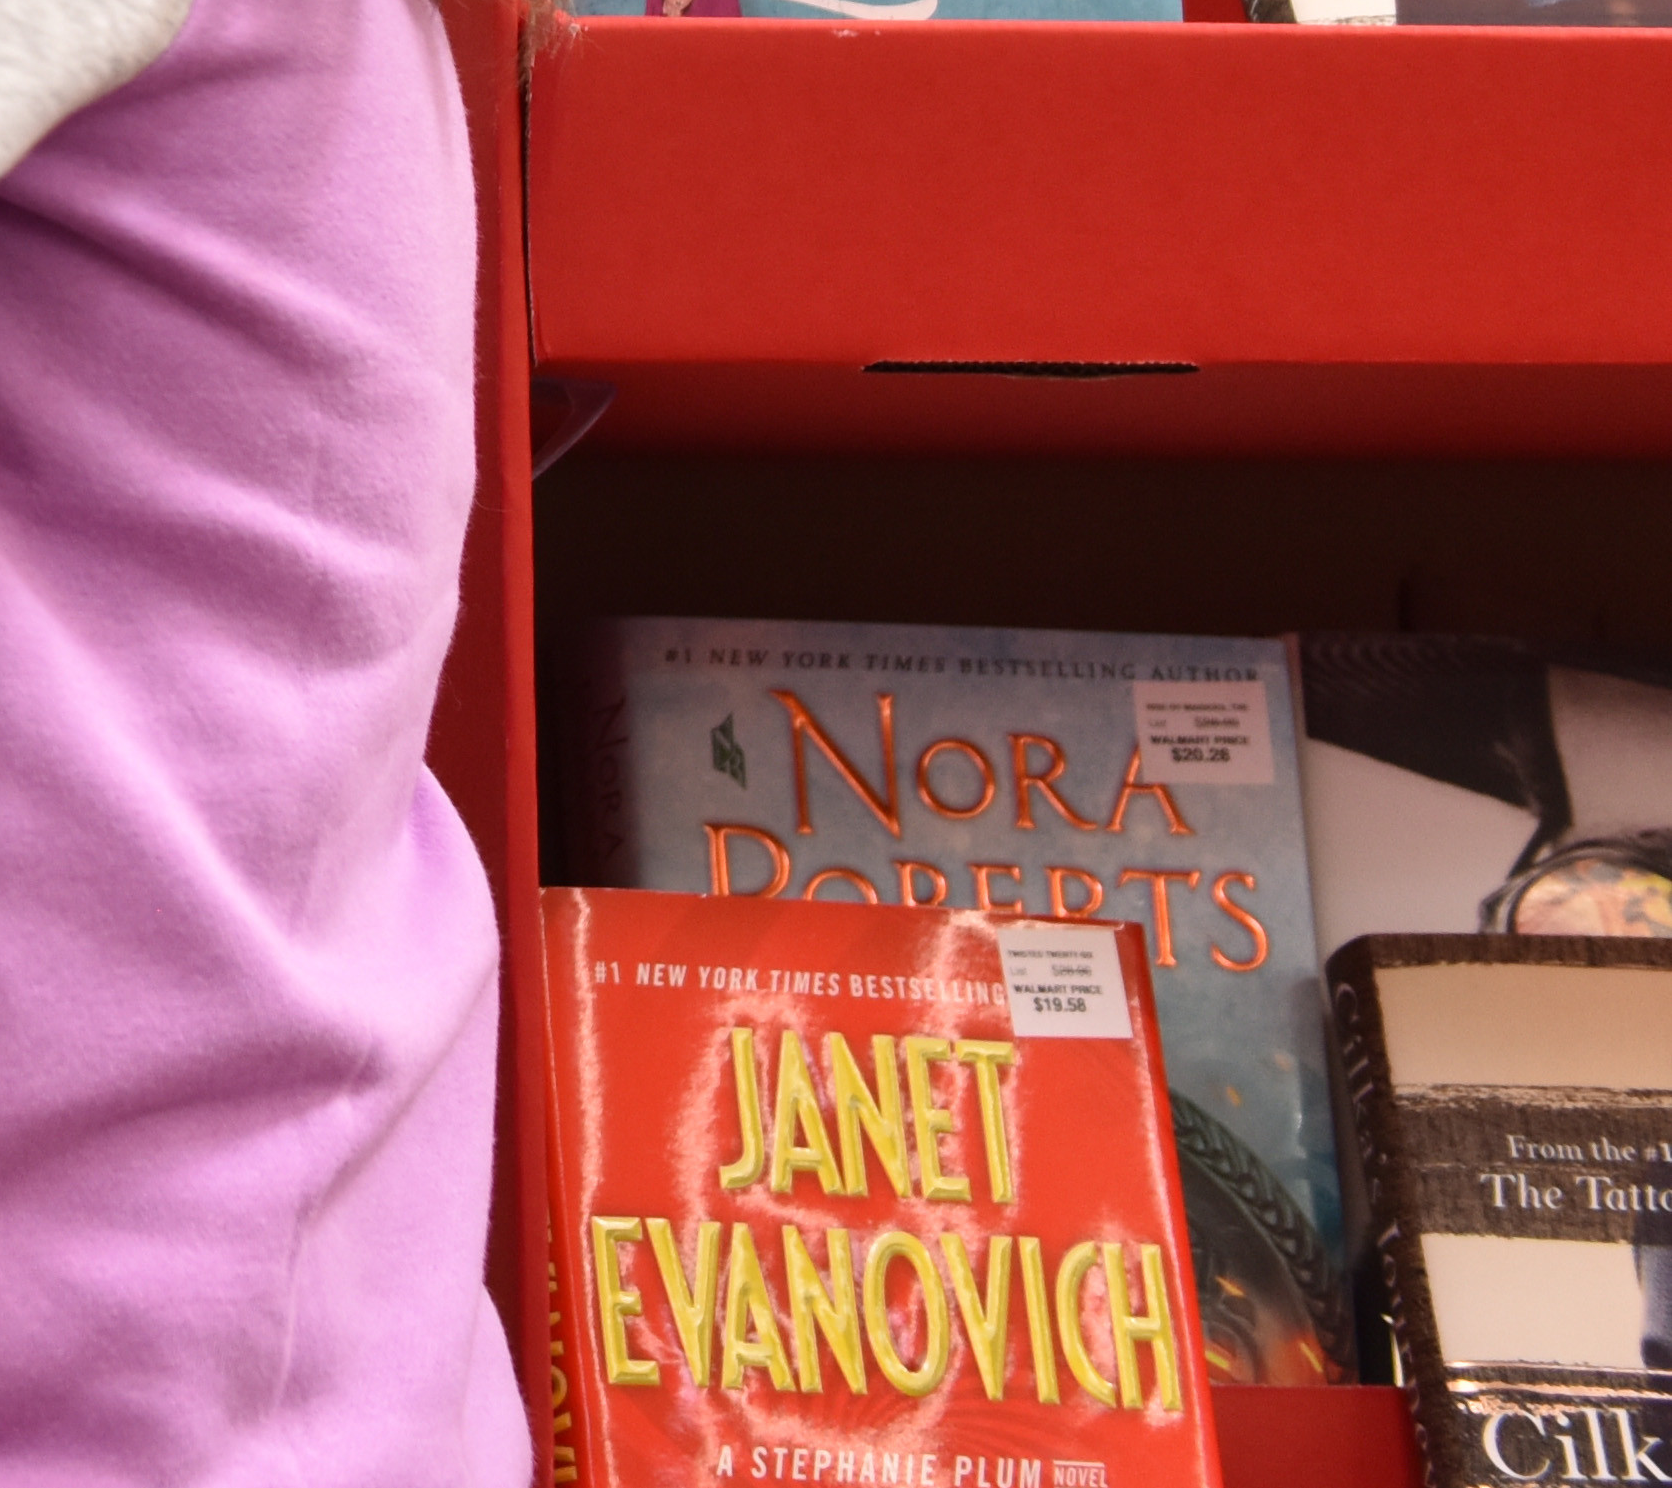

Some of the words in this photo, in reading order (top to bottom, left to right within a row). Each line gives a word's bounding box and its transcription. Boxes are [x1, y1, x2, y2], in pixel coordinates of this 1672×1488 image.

[709, 648, 769, 666] NEW
[781, 650, 851, 669] YORK
[866, 653, 946, 673] TIMES
[958, 657, 1136, 680] BESTSELLING
[1150, 666, 1259, 682] AUTHOR
[771, 689, 1196, 838] NORA
[594, 961, 621, 986] #1
[636, 962, 686, 988] NEW
[698, 965, 759, 992] YORK
[770, 968, 841, 997] TIMES
[848, 972, 1009, 1007] BESTSELLING
[1013, 984, 1067, 994] WALMART
[1071, 984, 1103, 995] PRICE
[1033, 997, 1087, 1012] $19.58
[718, 1027, 1015, 1204] JANET
[1505, 1133, 1584, 1160] From
[1589, 1136, 1637, 1162] the
[1479, 1173, 1564, 1210] The
[590, 1215, 1182, 1411] EVANOVICH
[716, 1444, 734, 1478] A
[751, 1444, 937, 1486] STEPHANIE
[954, 1455, 1042, 1488] PLUM
[1053, 1463, 1109, 1488] NOVEL
[1482, 1407, 1672, 1482] Cilk
